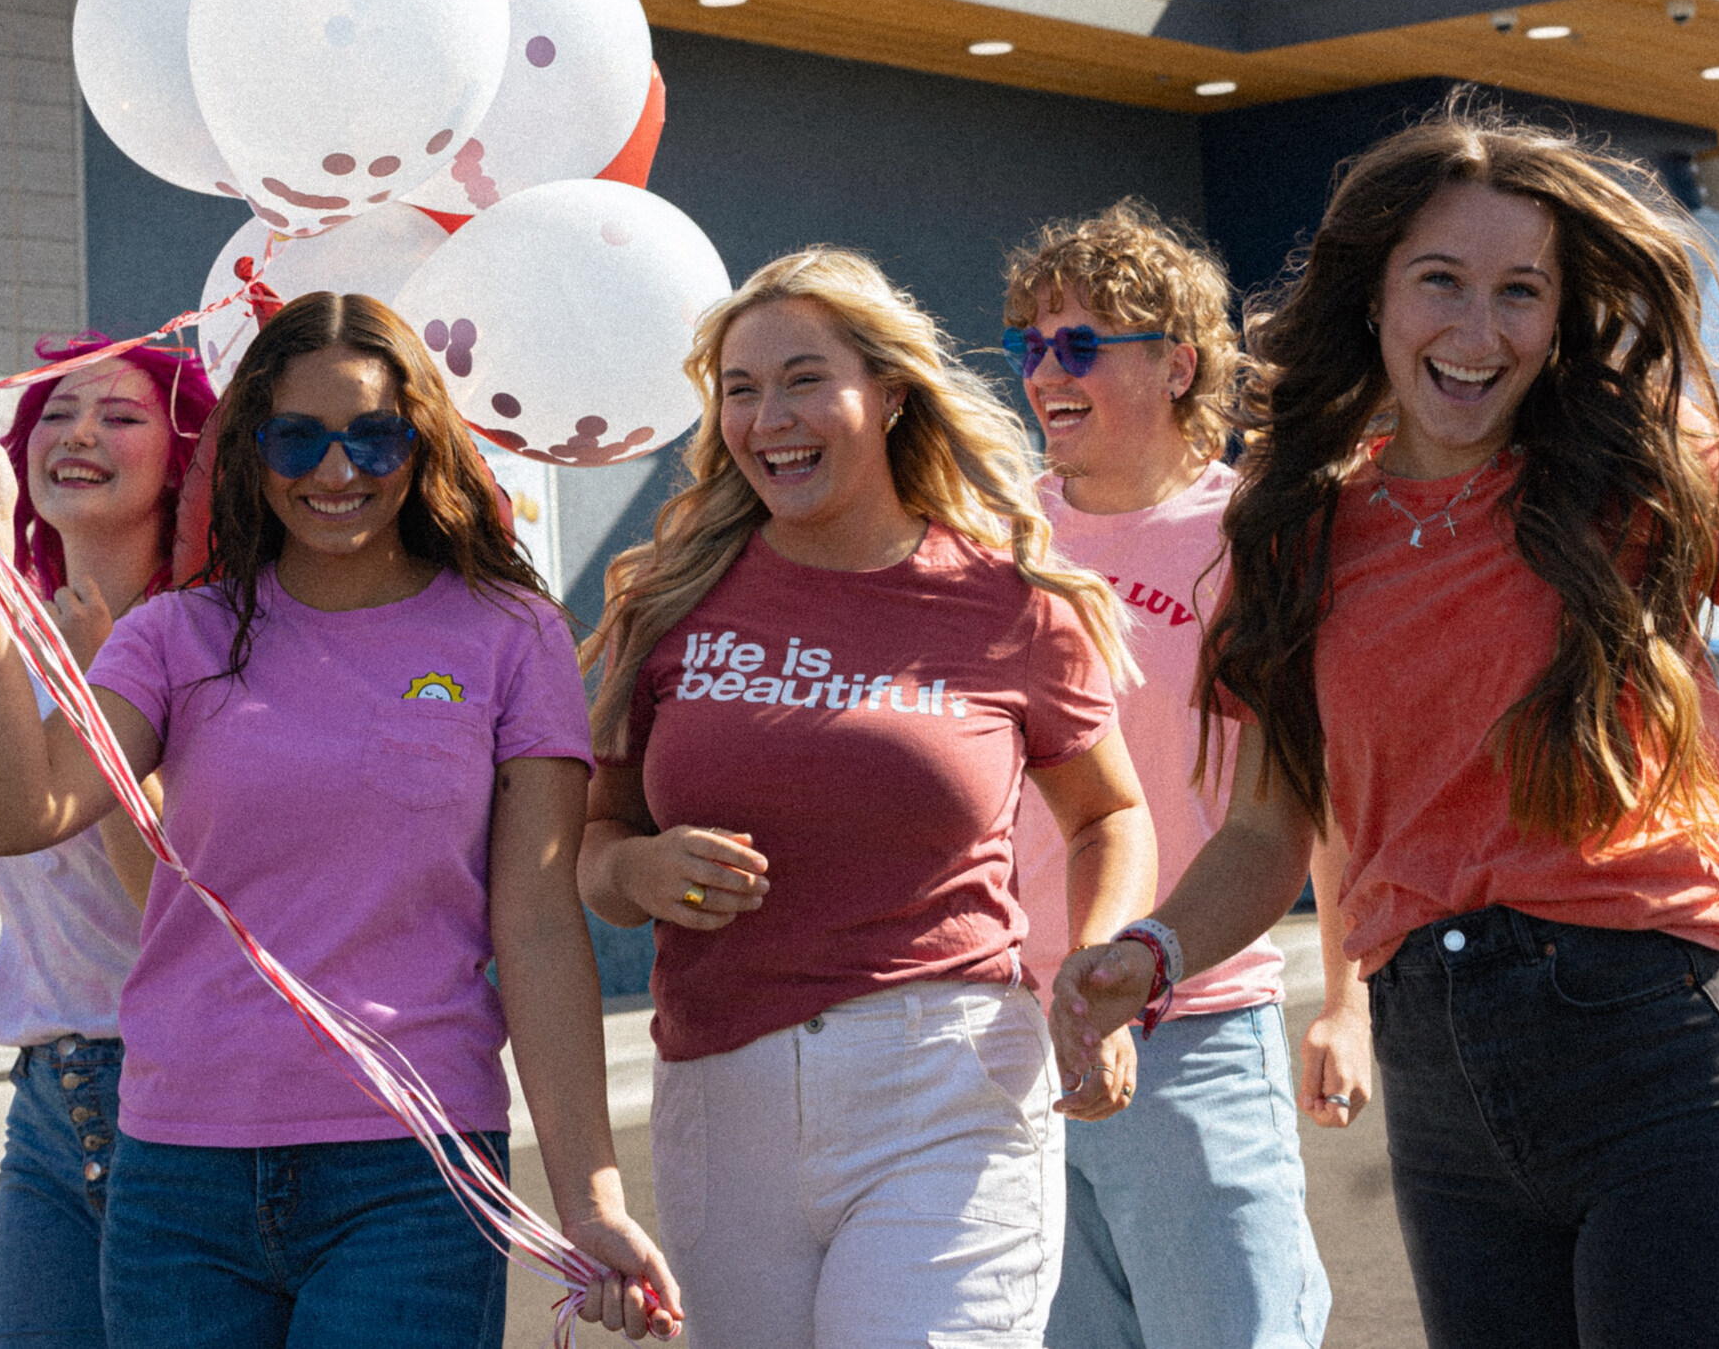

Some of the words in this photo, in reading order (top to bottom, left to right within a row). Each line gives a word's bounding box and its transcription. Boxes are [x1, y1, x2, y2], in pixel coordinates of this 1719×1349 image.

[1125, 582, 1196, 628] LUV
[682, 631, 766, 673] life
[782, 637, 832, 678] is
[676, 667, 946, 717] beautiful
